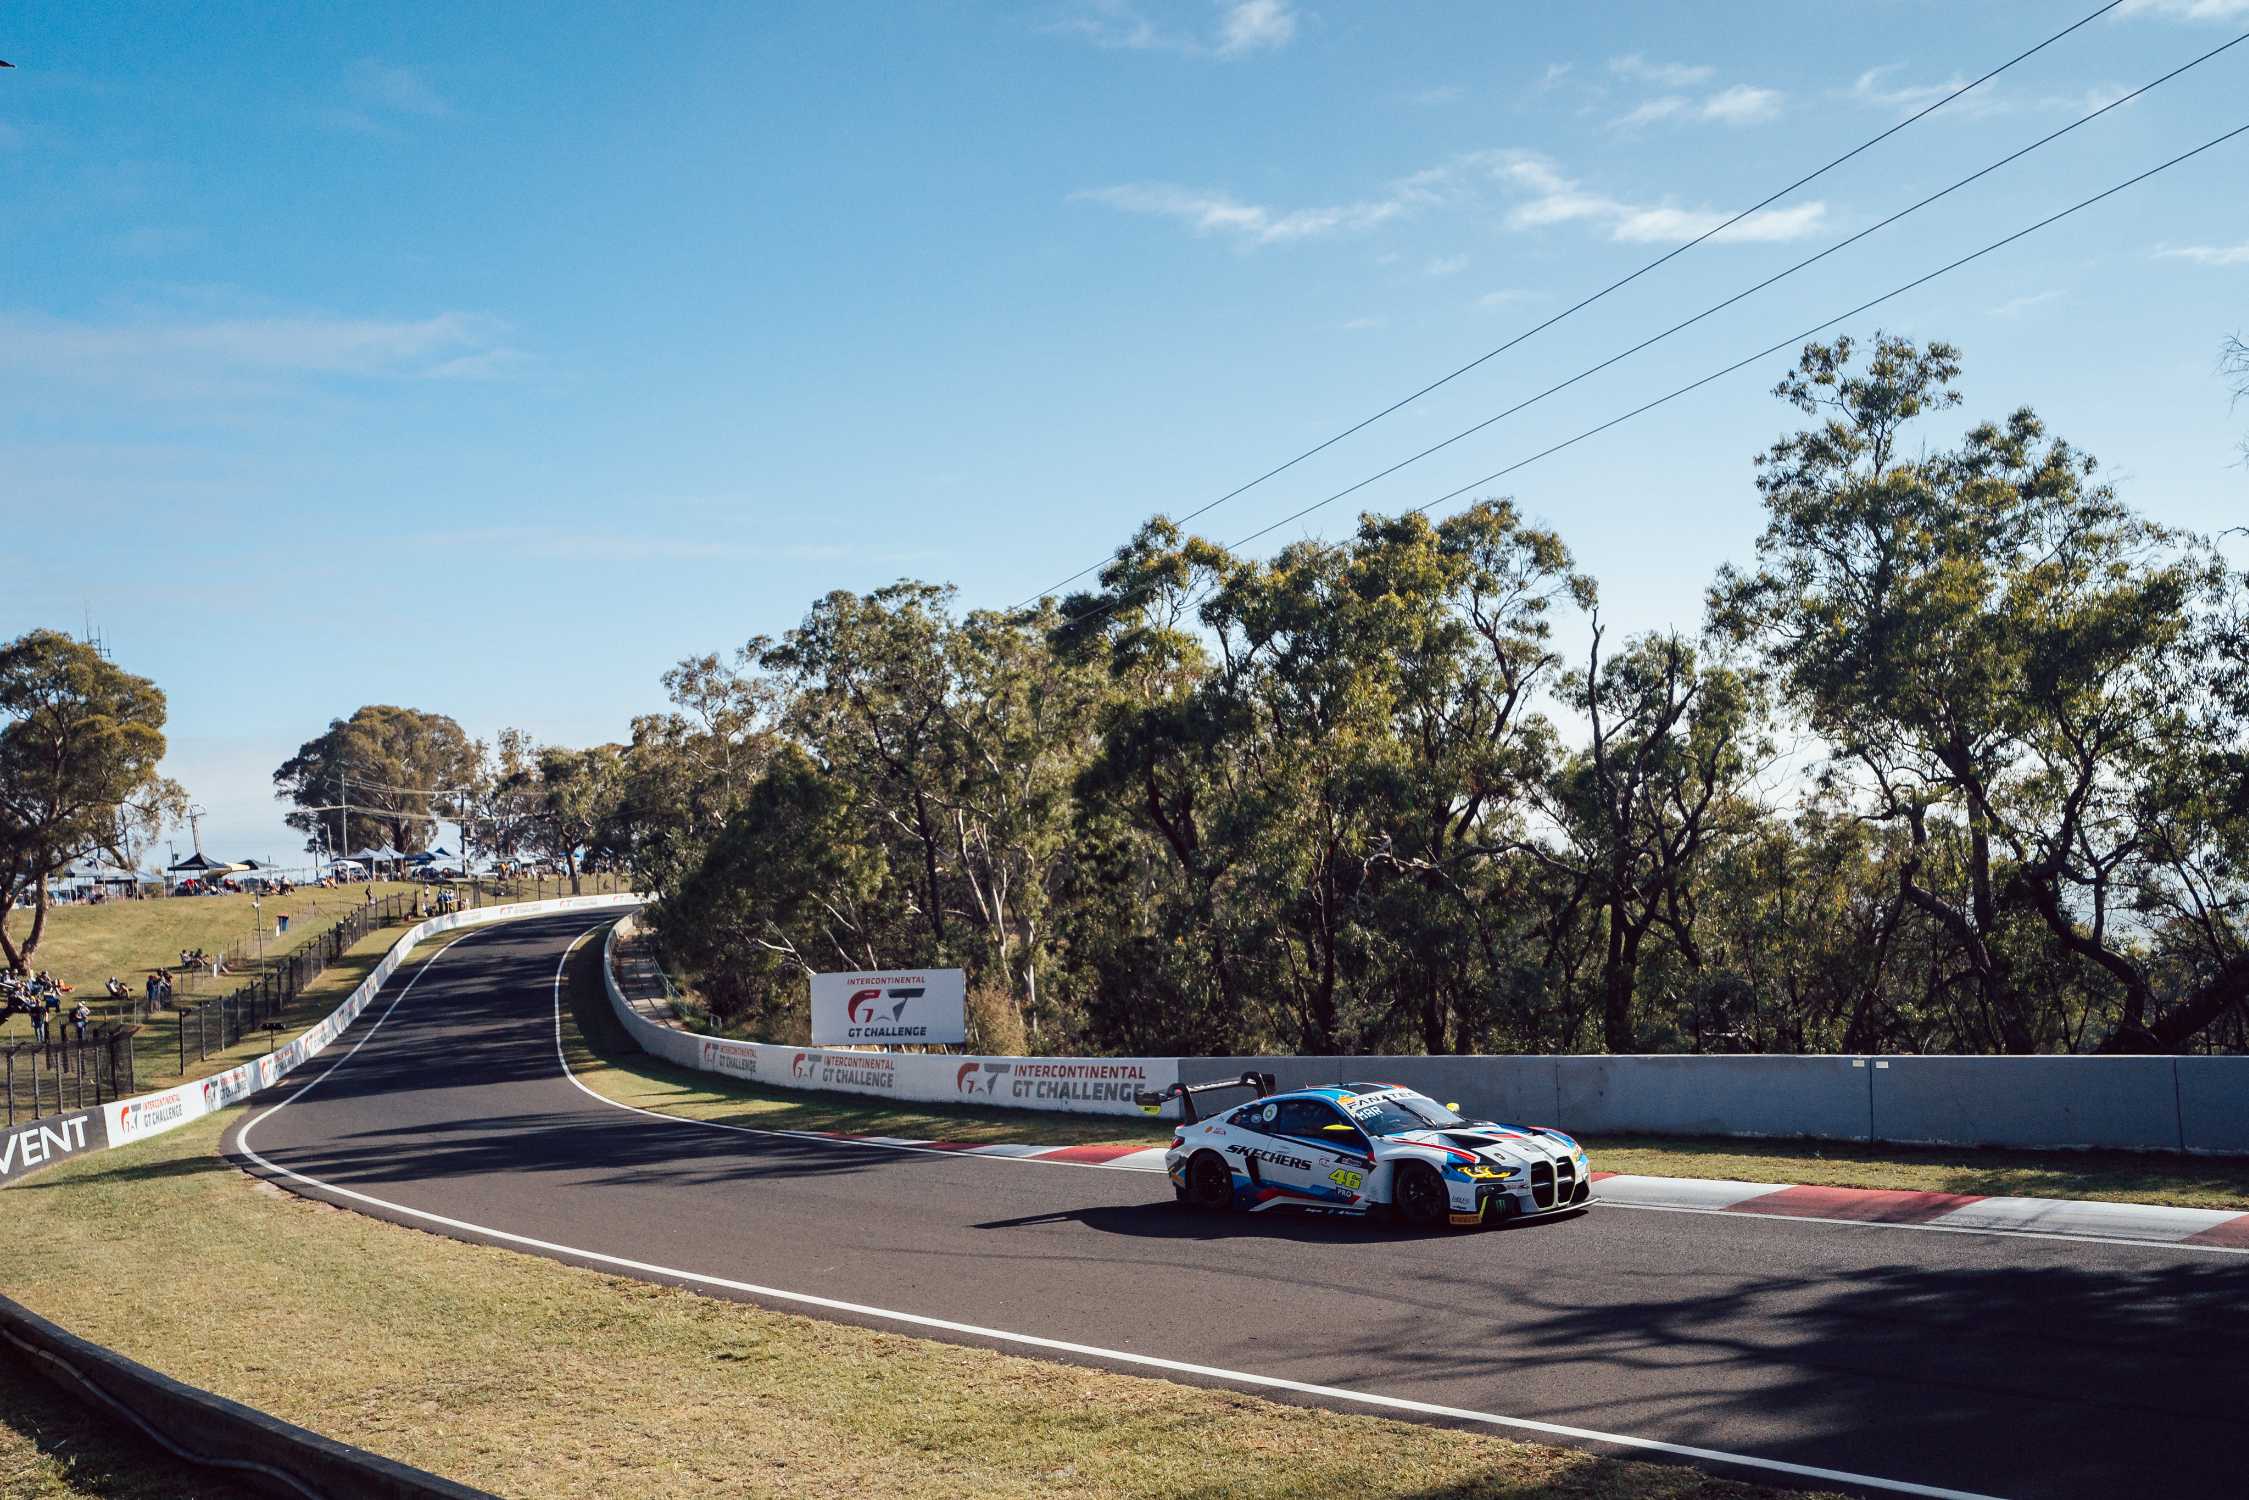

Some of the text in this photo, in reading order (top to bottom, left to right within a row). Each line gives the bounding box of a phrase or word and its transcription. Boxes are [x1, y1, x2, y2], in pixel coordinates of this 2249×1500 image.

[847, 976, 926, 985] INTERCONTINENTAL
[848, 1026, 927, 1038] GT CHALLENGE
[824, 1055, 895, 1071] INTERCONTINENTAL
[823, 1068, 894, 1088] GT CHALLENGE
[1014, 1064, 1147, 1079] INTERCONTINENTAL
[1012, 1079, 1035, 1097] GT
[151, 1104, 183, 1125] CHALLENGE
[1355, 1105, 1383, 1121] MAR
[1225, 1144, 1312, 1171] SKECHERS
[1328, 1167, 1362, 1190] 46
[1337, 1188, 1352, 1198] PRO
